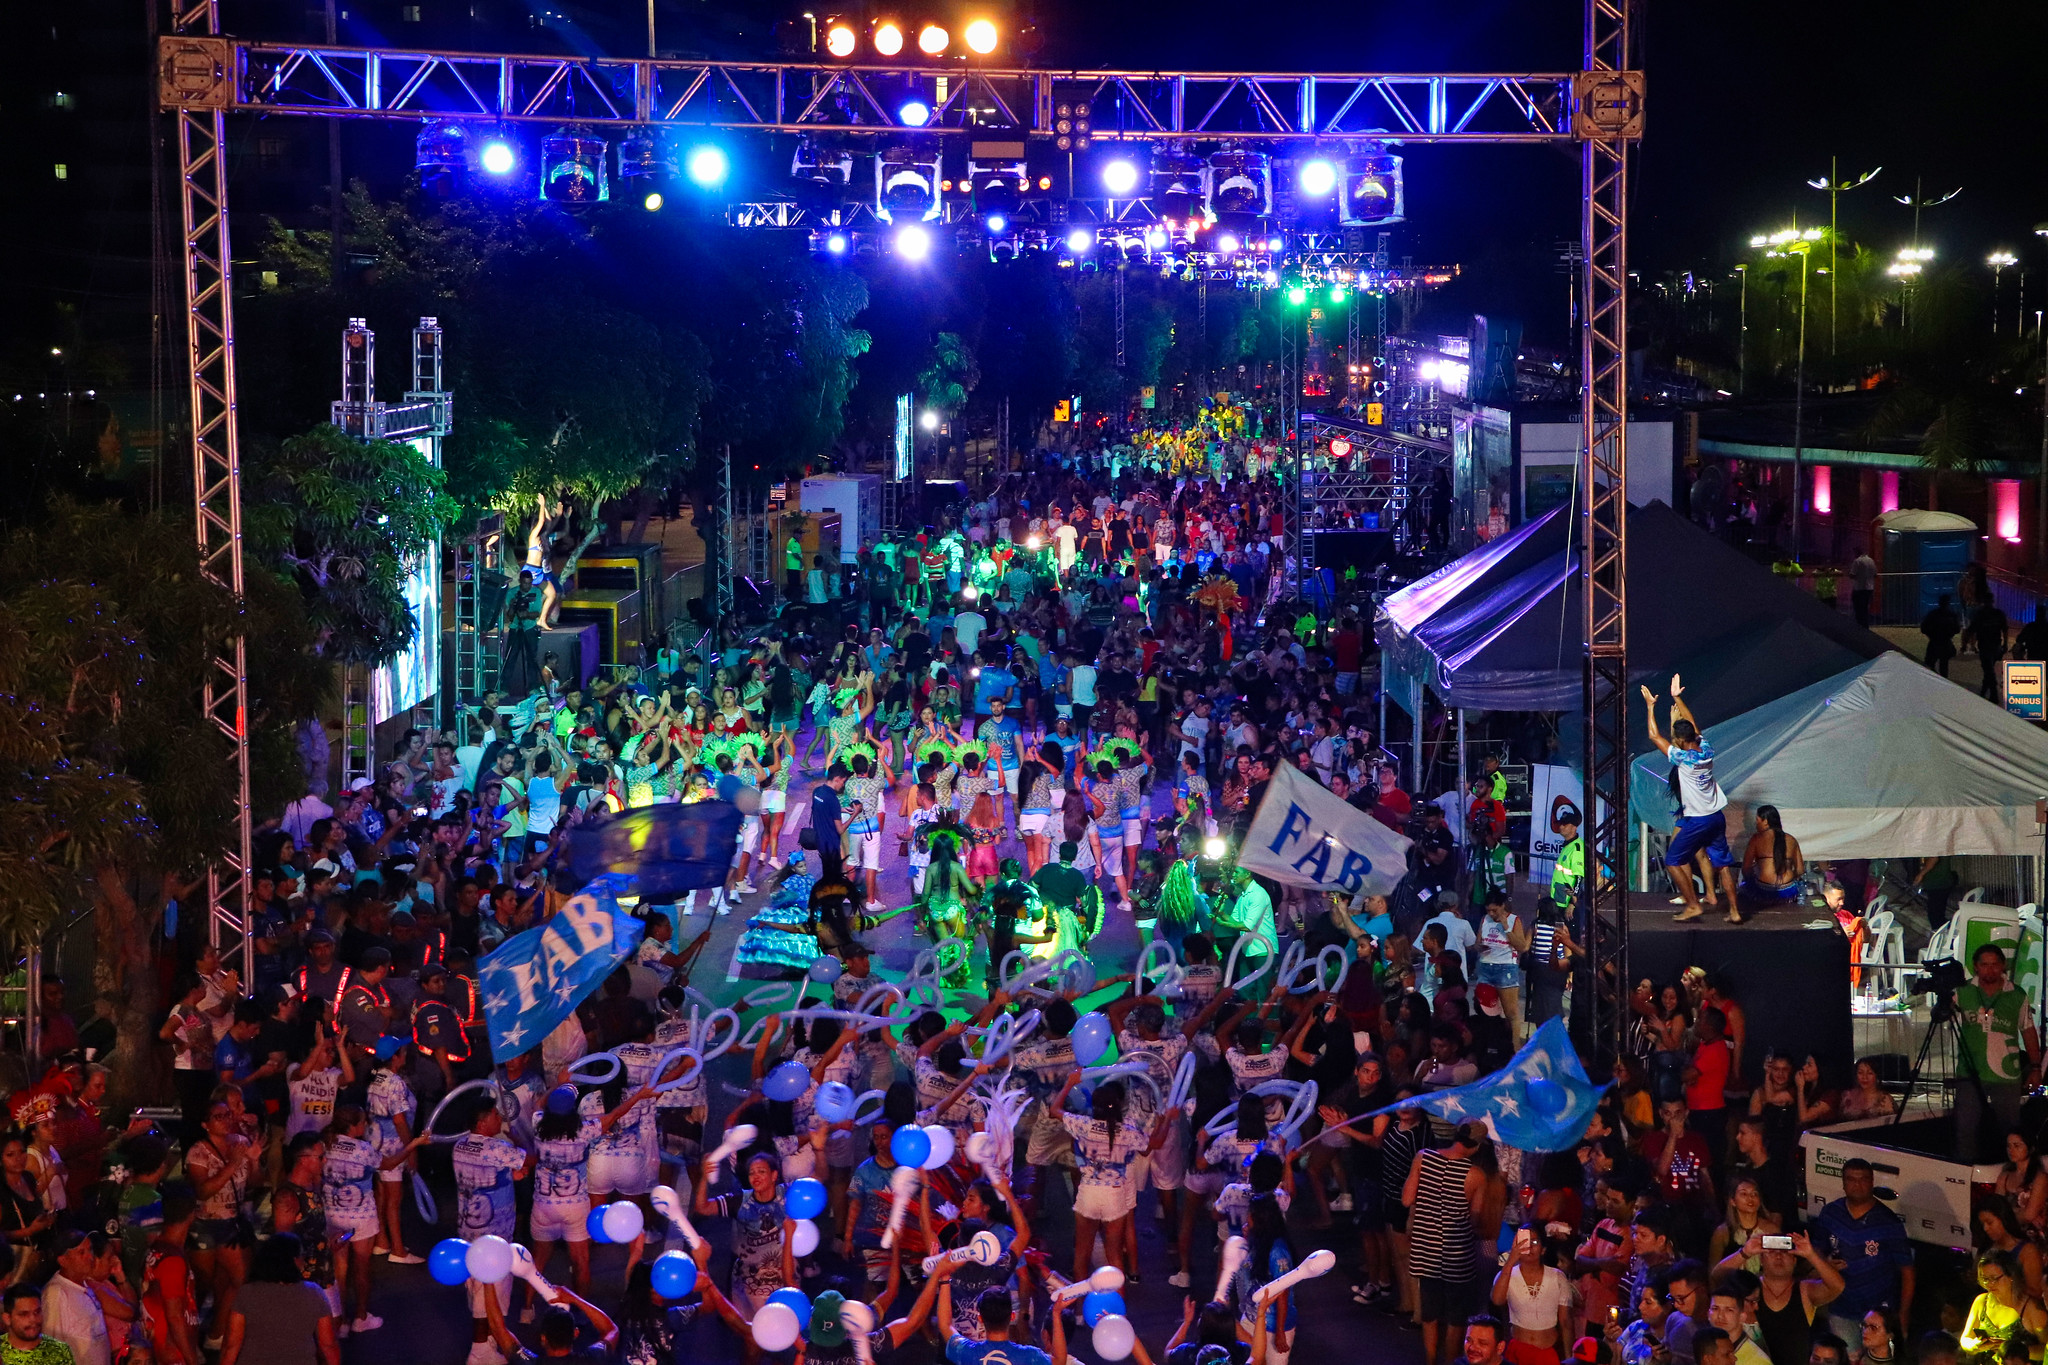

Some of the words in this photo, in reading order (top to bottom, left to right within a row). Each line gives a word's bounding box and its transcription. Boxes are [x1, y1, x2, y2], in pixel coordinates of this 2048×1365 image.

[2008, 695, 2041, 705] ÔNIBUS
[1267, 800, 1373, 893] FAB
[507, 893, 614, 1015] FAB
[304, 1105, 331, 1115] LESS
[1817, 1167, 1834, 1176] APOIO
